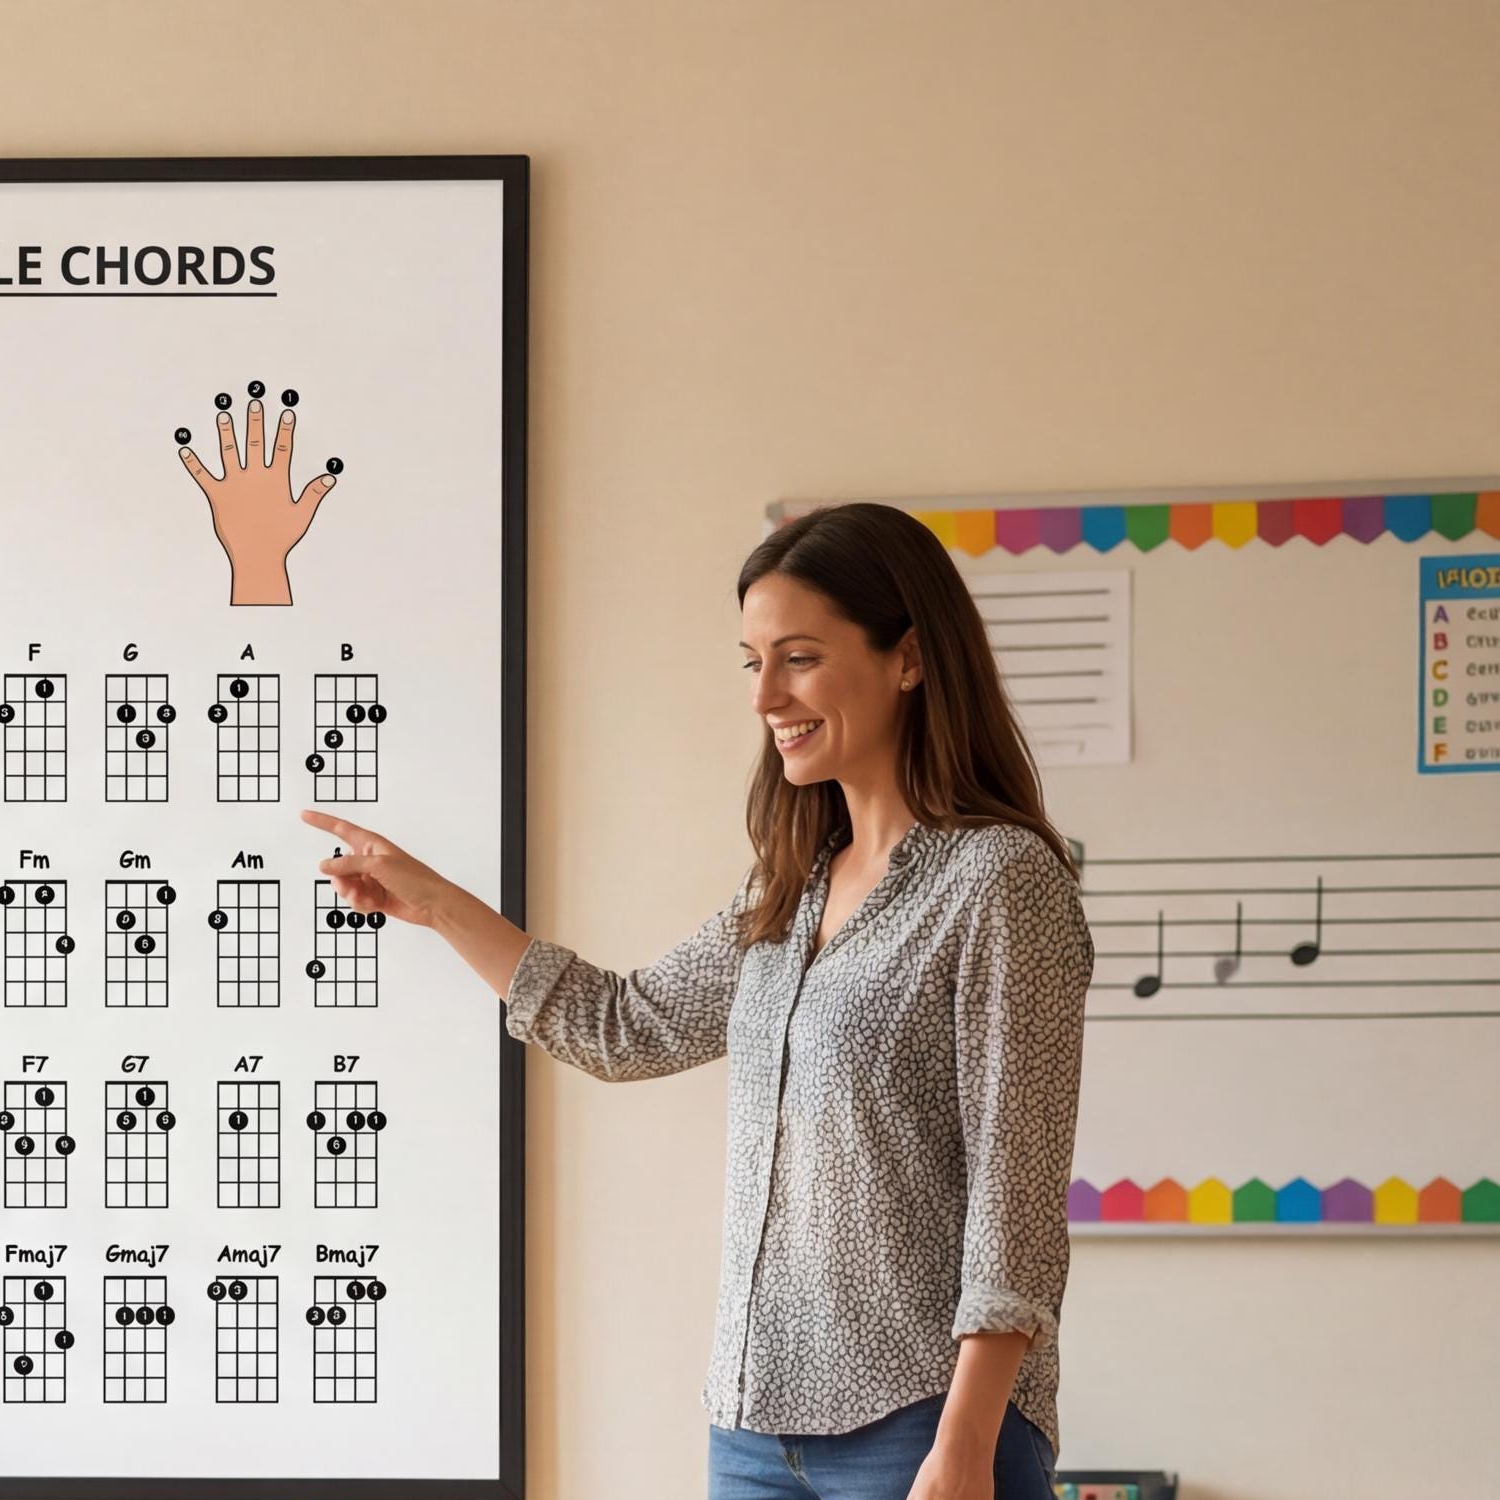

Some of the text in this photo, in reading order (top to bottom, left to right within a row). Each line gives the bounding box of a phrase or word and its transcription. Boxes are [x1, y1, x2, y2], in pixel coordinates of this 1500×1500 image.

[61, 246, 275, 285] CHORDS
[1433, 605, 1449, 623] A
[1433, 632, 1448, 650] B
[29, 644, 41, 661] F
[123, 643, 138, 661] G
[241, 644, 254, 660] A
[341, 644, 353, 661] B
[1432, 660, 1448, 680] C
[1432, 689, 1448, 707] D
[1433, 717, 1447, 735] E
[1433, 744, 1447, 762] F
[20, 850, 49, 869] Fm
[120, 850, 150, 869] Gm
[232, 851, 263, 869] Am
[23, 1056, 49, 1072] F7
[122, 1056, 149, 1073] G7
[235, 1056, 263, 1072] A7
[334, 1055, 359, 1072] B7
[6, 1245, 67, 1268] Fmaj7
[106, 1245, 168, 1268] Gmaj7
[217, 1245, 281, 1268] Amaj7
[317, 1245, 379, 1267] Bmaj7
